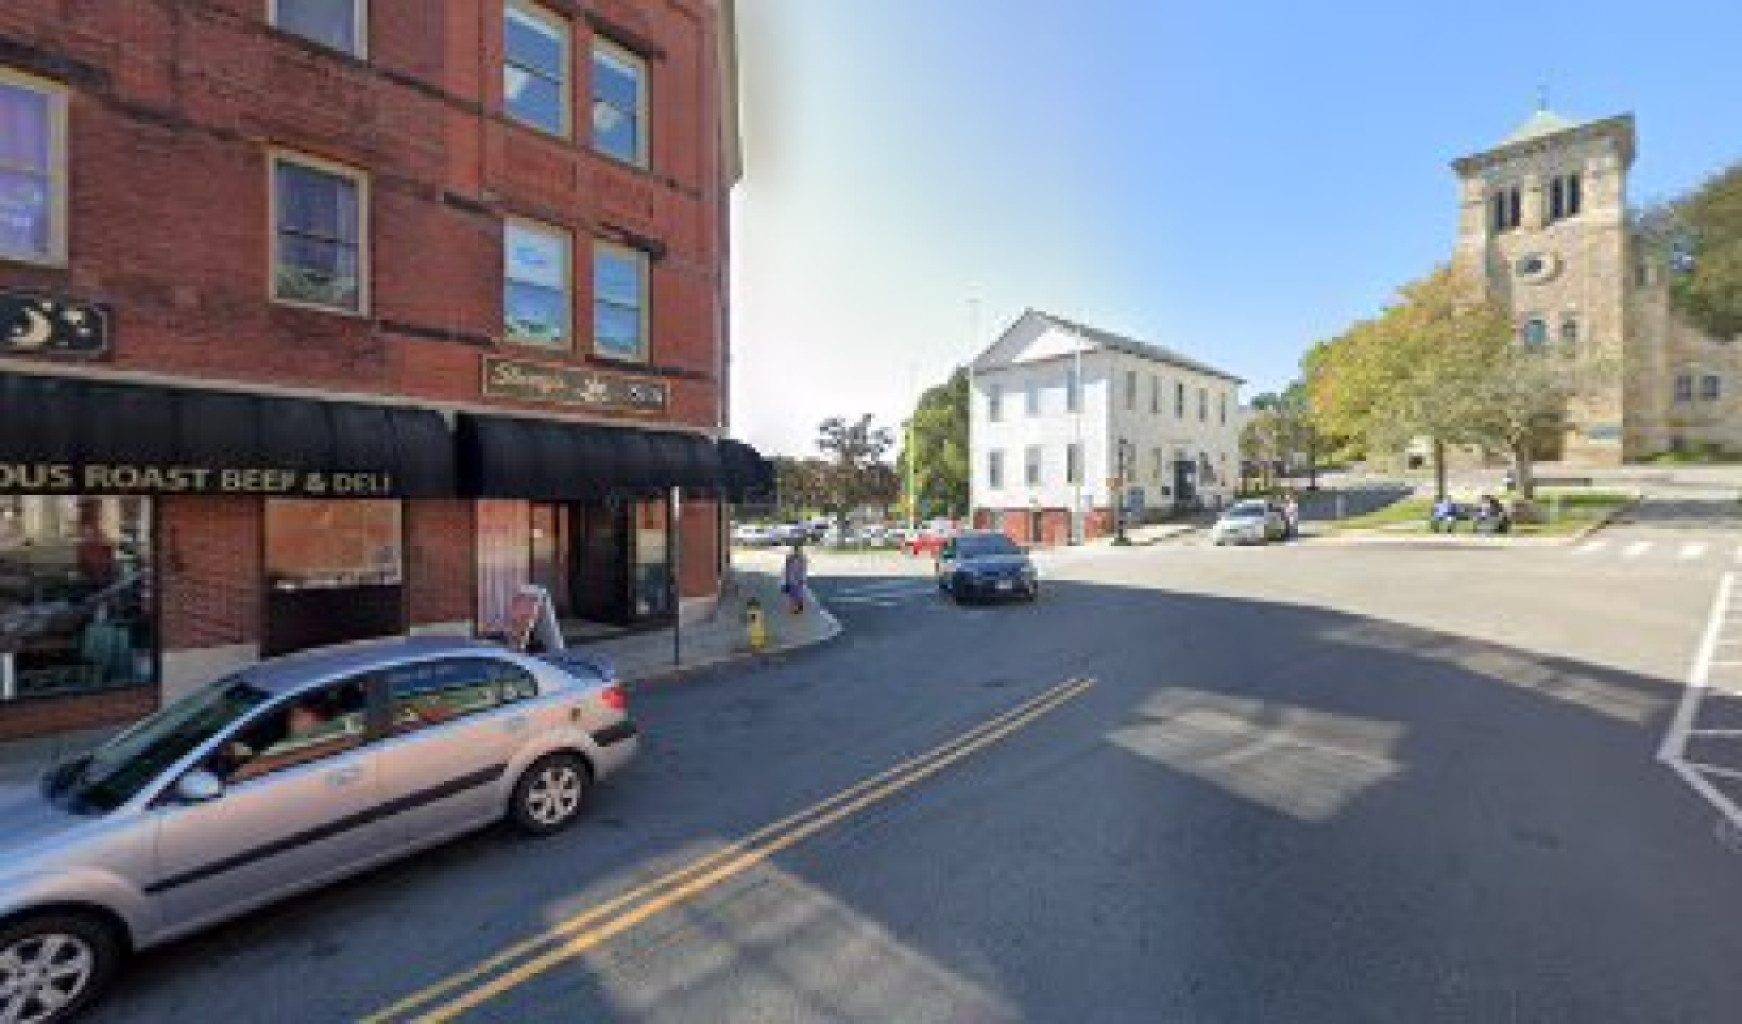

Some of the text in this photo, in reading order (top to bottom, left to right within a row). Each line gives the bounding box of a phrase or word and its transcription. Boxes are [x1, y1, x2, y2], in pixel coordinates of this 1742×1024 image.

[84, 464, 210, 491] ROAST
[221, 469, 296, 492] BEEF
[304, 472, 326, 492] &
[332, 471, 390, 494] DELI
